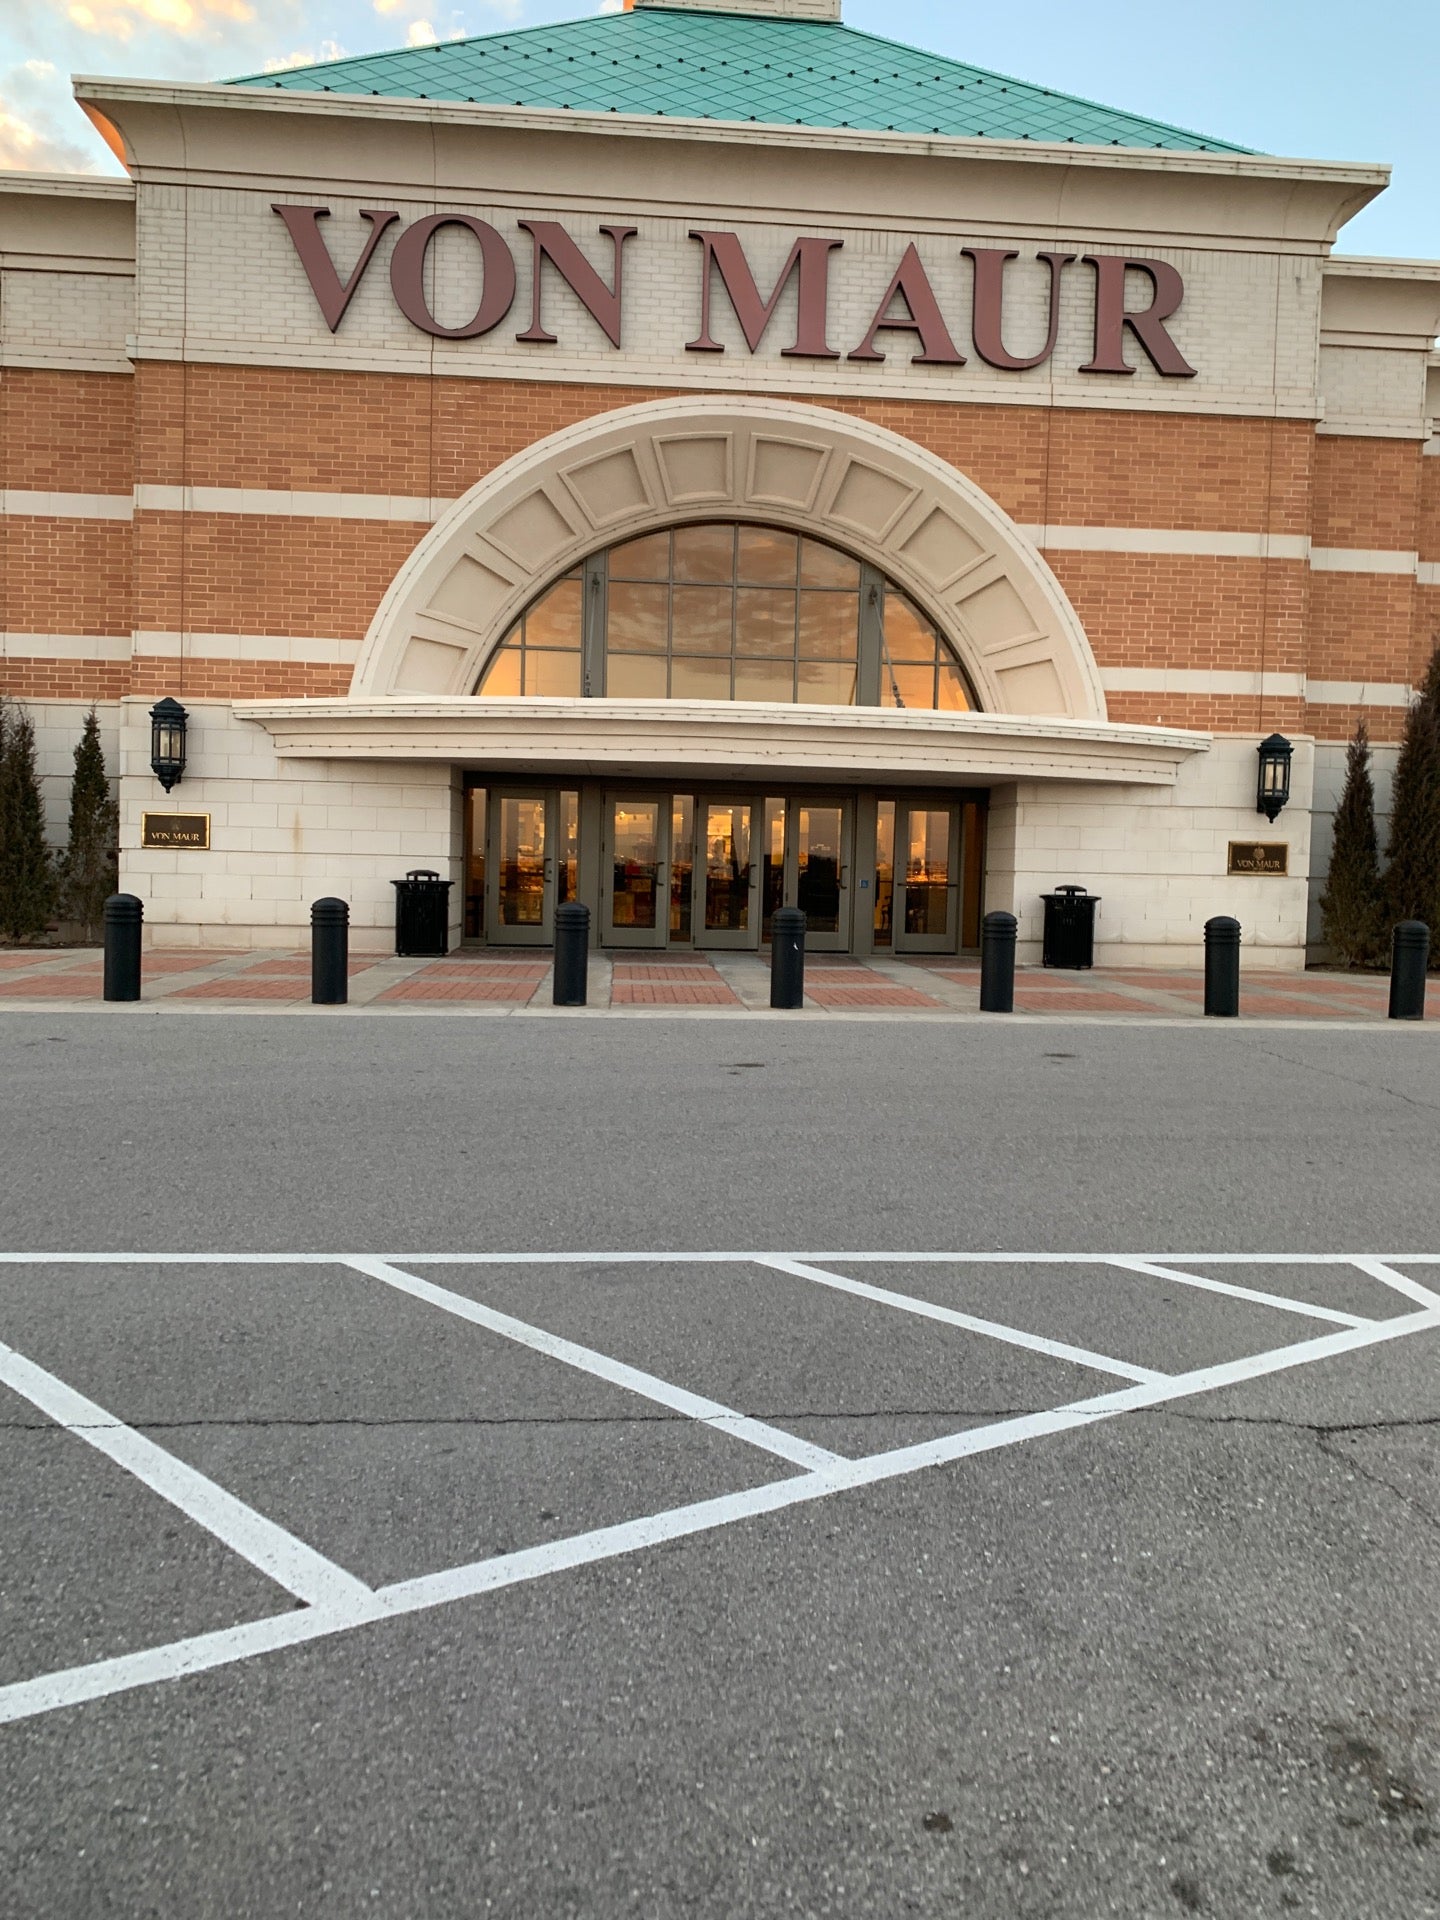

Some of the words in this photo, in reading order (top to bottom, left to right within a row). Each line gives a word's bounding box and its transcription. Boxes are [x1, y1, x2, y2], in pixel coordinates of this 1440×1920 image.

[271, 204, 638, 349] VON
[685, 229, 1198, 378] MAUR
[151, 832, 170, 840] VON
[173, 832, 200, 841] MAUR
[1237, 859, 1254, 867] VON
[1256, 860, 1280, 868] MAUR
